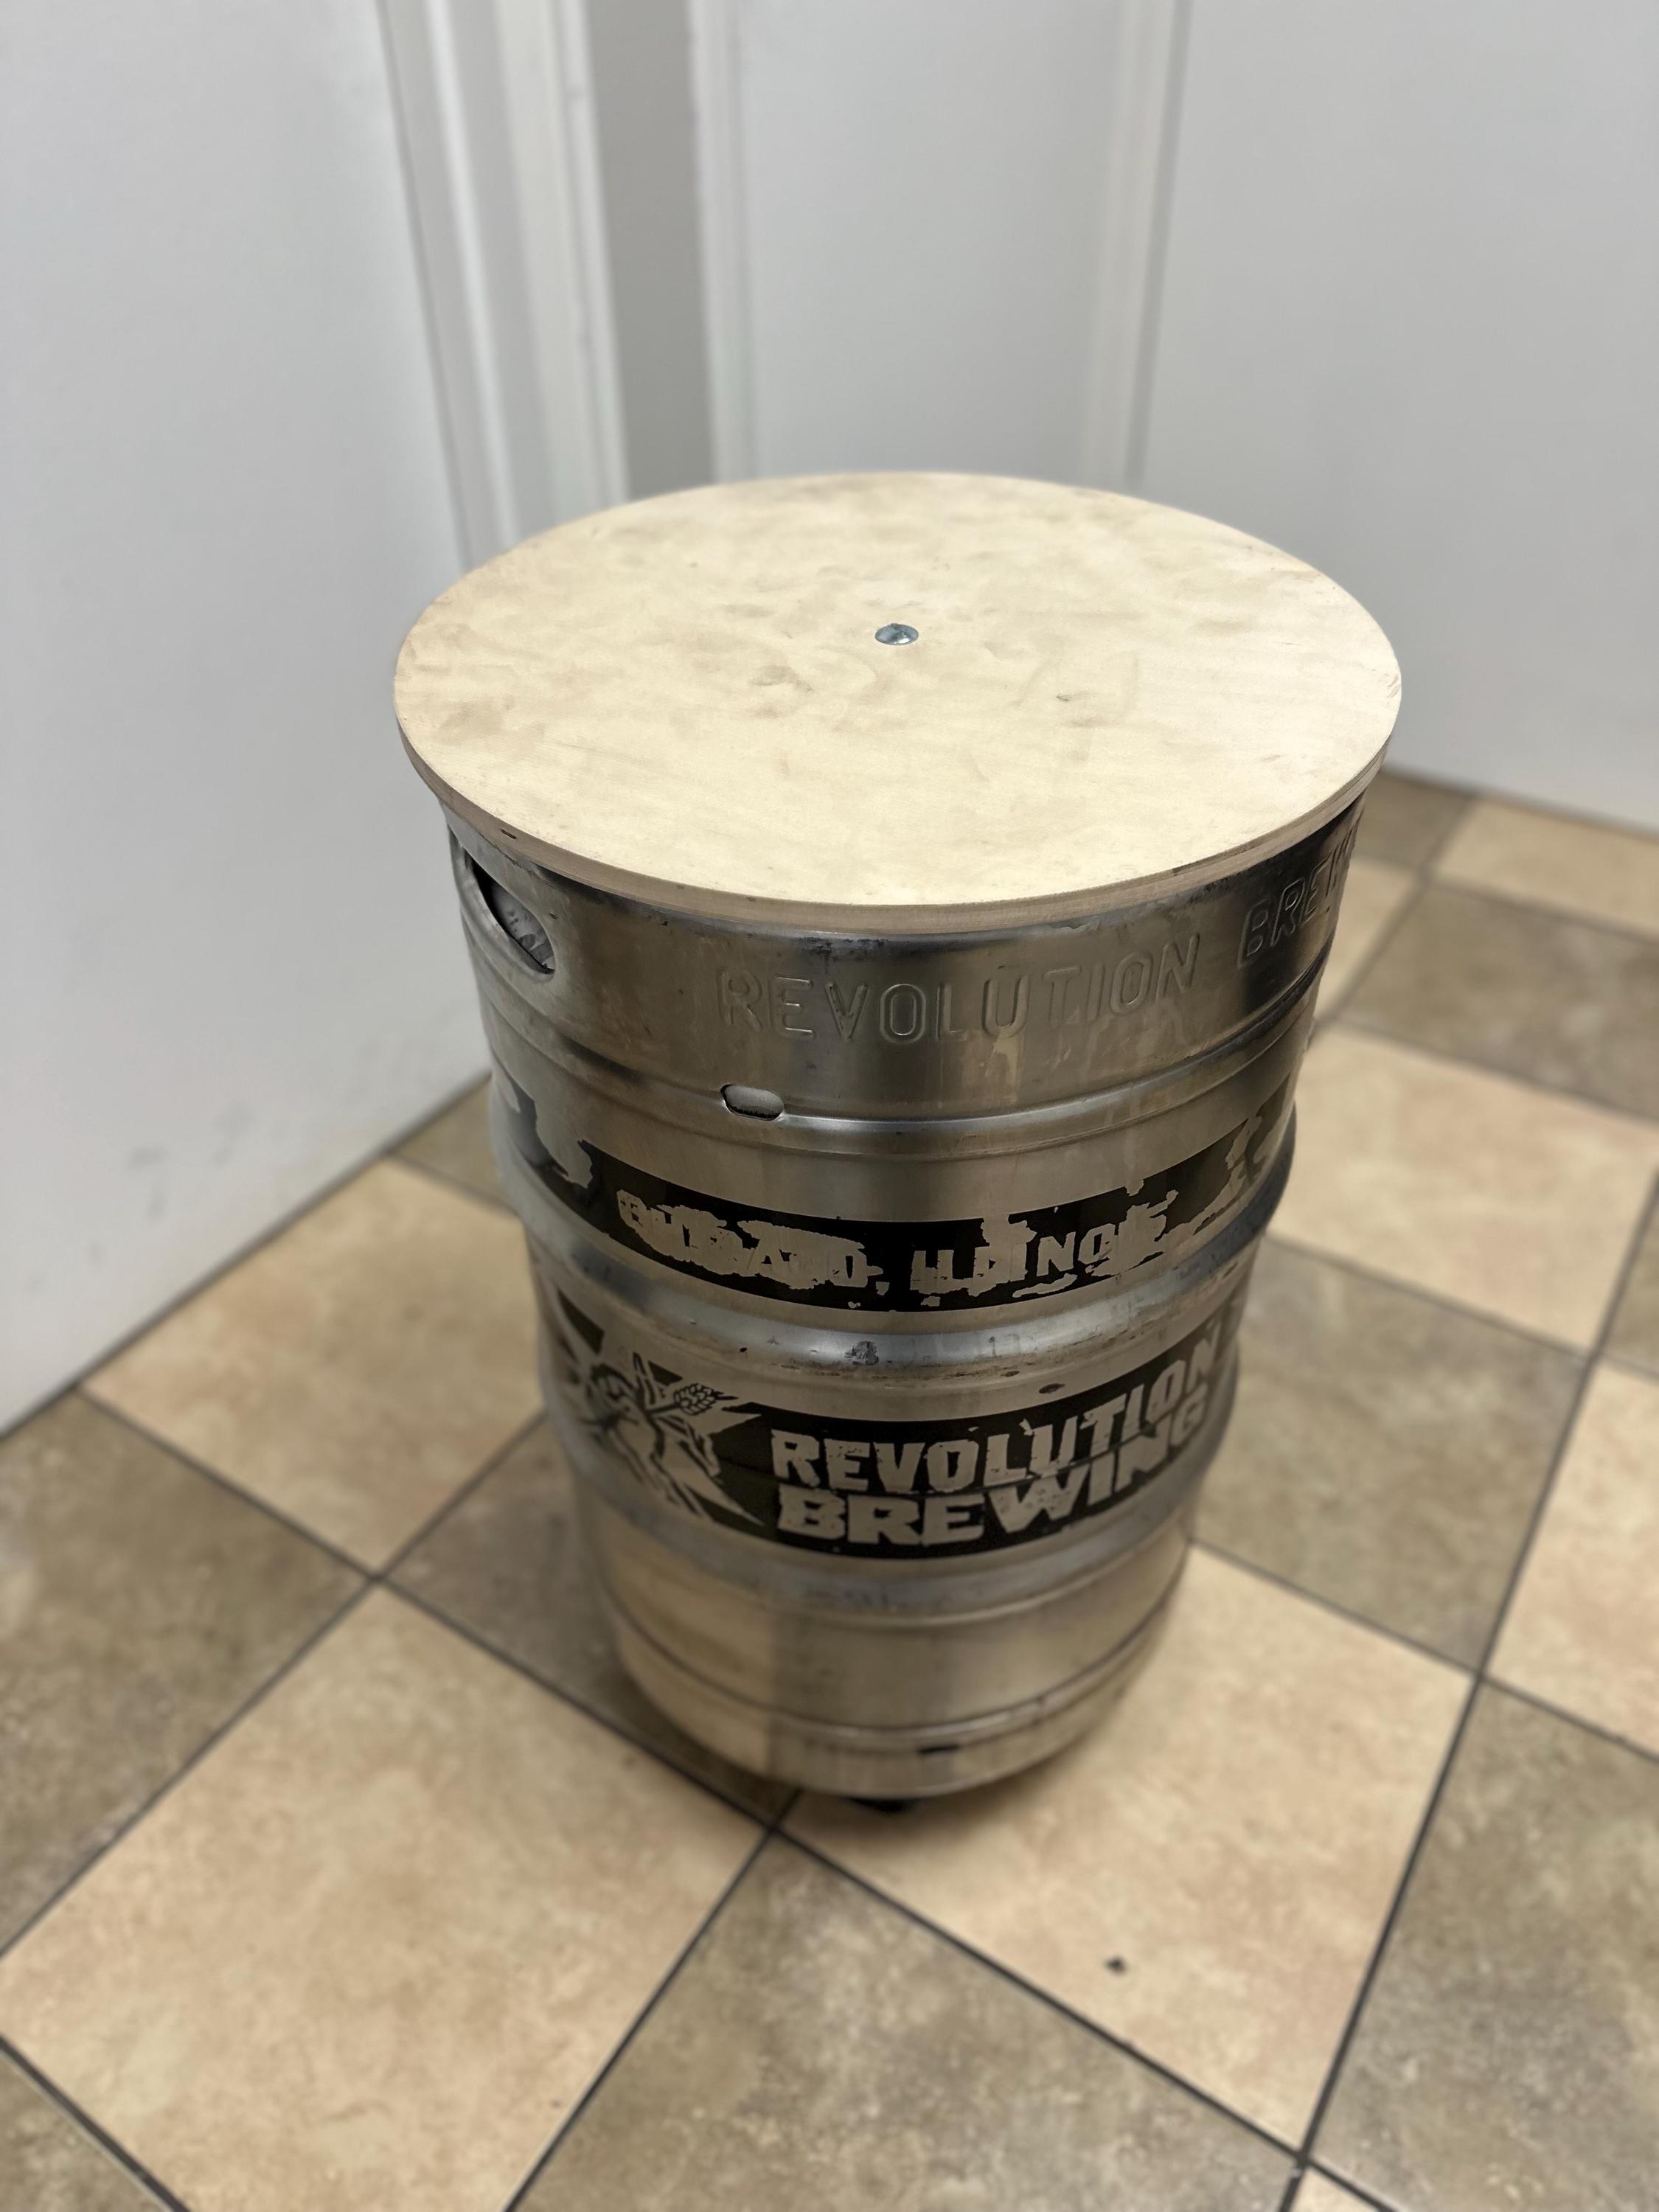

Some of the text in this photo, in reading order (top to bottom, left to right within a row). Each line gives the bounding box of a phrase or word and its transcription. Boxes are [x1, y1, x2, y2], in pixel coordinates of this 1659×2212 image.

[716, 932, 1201, 1046] REVOLUTION
[771, 1320, 1222, 1495] REVOLUTION
[777, 1382, 1208, 1547] BREWING
